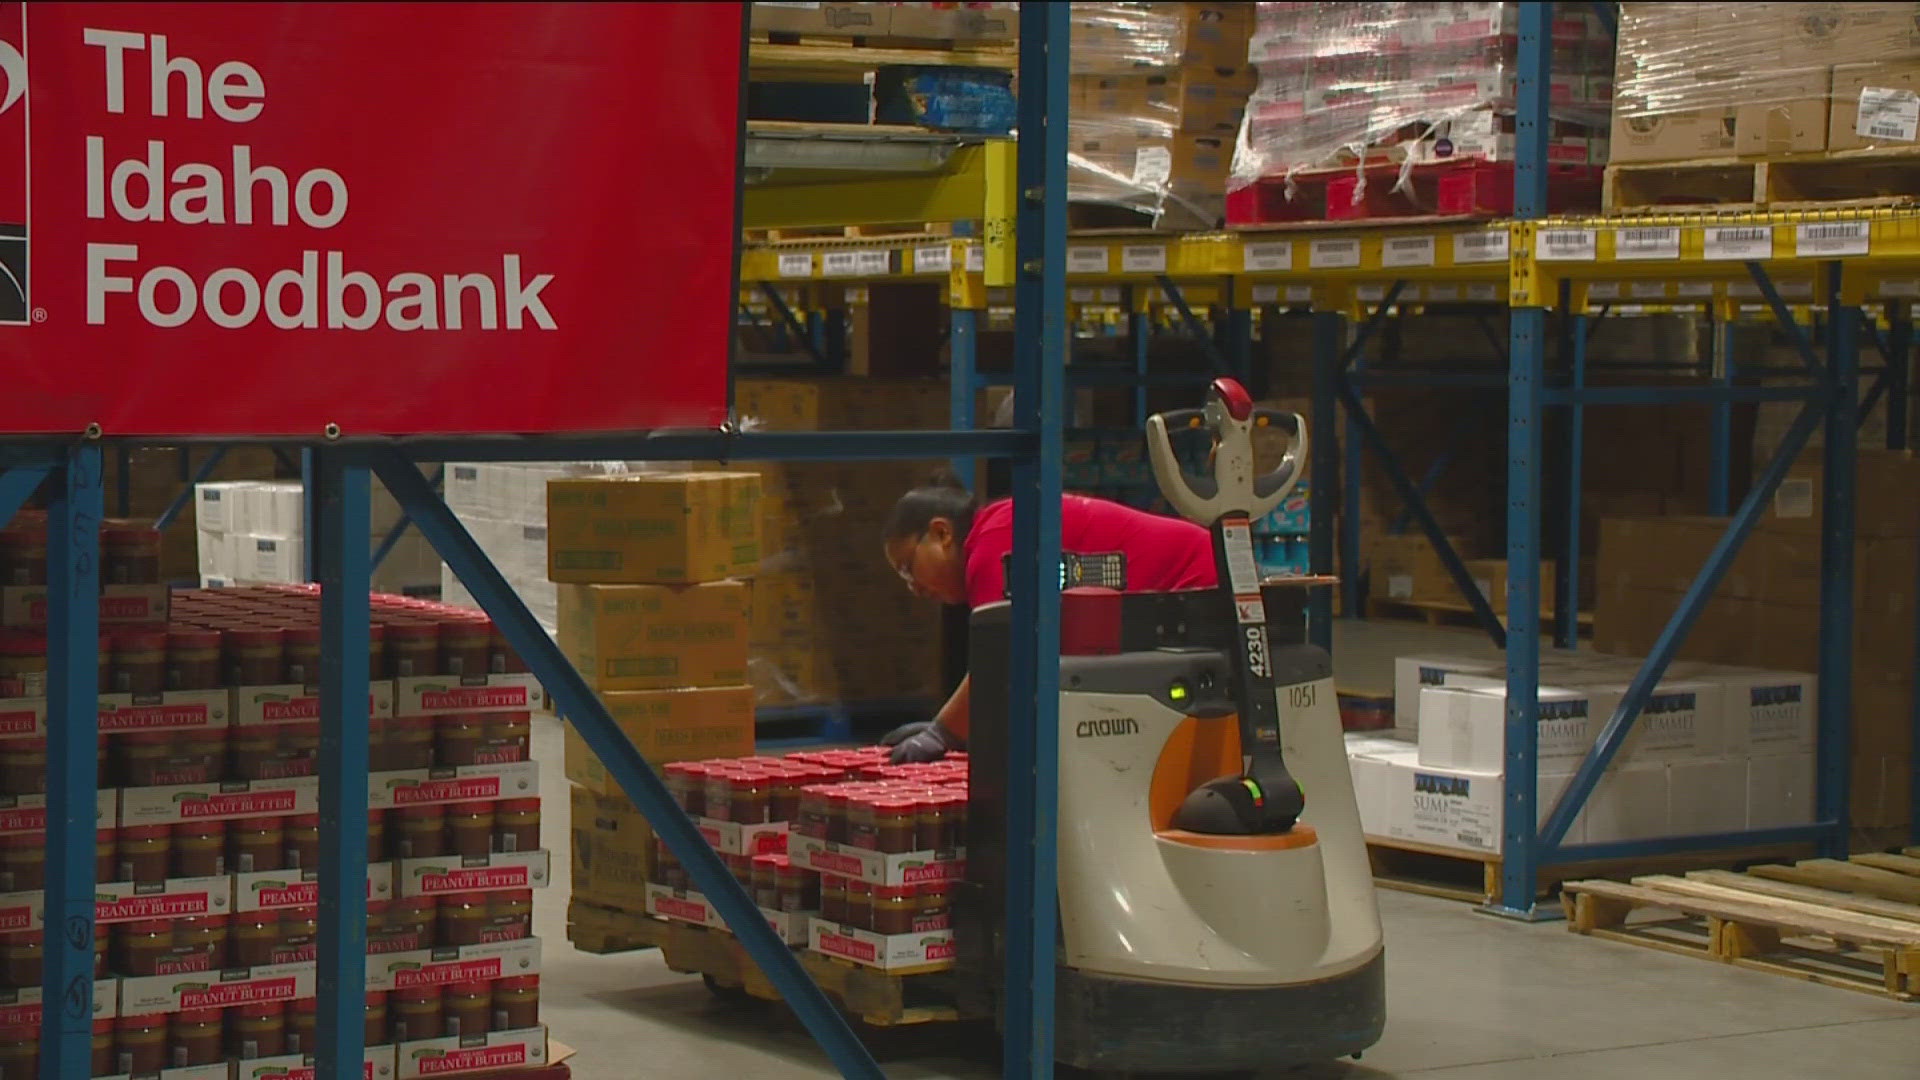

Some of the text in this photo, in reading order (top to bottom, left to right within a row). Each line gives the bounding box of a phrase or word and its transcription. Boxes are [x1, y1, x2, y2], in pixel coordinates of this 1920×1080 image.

[83, 27, 266, 123] The
[86, 135, 349, 229] Idaho
[87, 242, 558, 331] Foodbank
[1246, 627, 1265, 678] 4230
[424, 693, 525, 708] PEANUT BUTTER
[1289, 685, 1316, 708] 1051
[96, 713, 147, 728] EANUT
[151, 710, 204, 724] BUTTER
[1538, 722, 1588, 738] UMMIT
[396, 784, 497, 801] PEANUT BUTTER
[183, 800, 237, 816] PEANUT
[240, 797, 294, 811] BUTTER
[1413, 795, 1450, 814] SUM
[424, 873, 525, 890] PEANUT BUTTER
[905, 865, 945, 881] PEANUT
[262, 890, 315, 905] PEANUT
[151, 899, 205, 915] BUTTER
[0, 914, 27, 929] TER
[159, 960, 208, 975] PEANUT
[398, 965, 498, 985] PEANUT BUTTER
[182, 990, 238, 1006] PEANUT
[240, 985, 294, 999] BUTTER
[422, 1051, 523, 1072] PEANUT BUTTER
